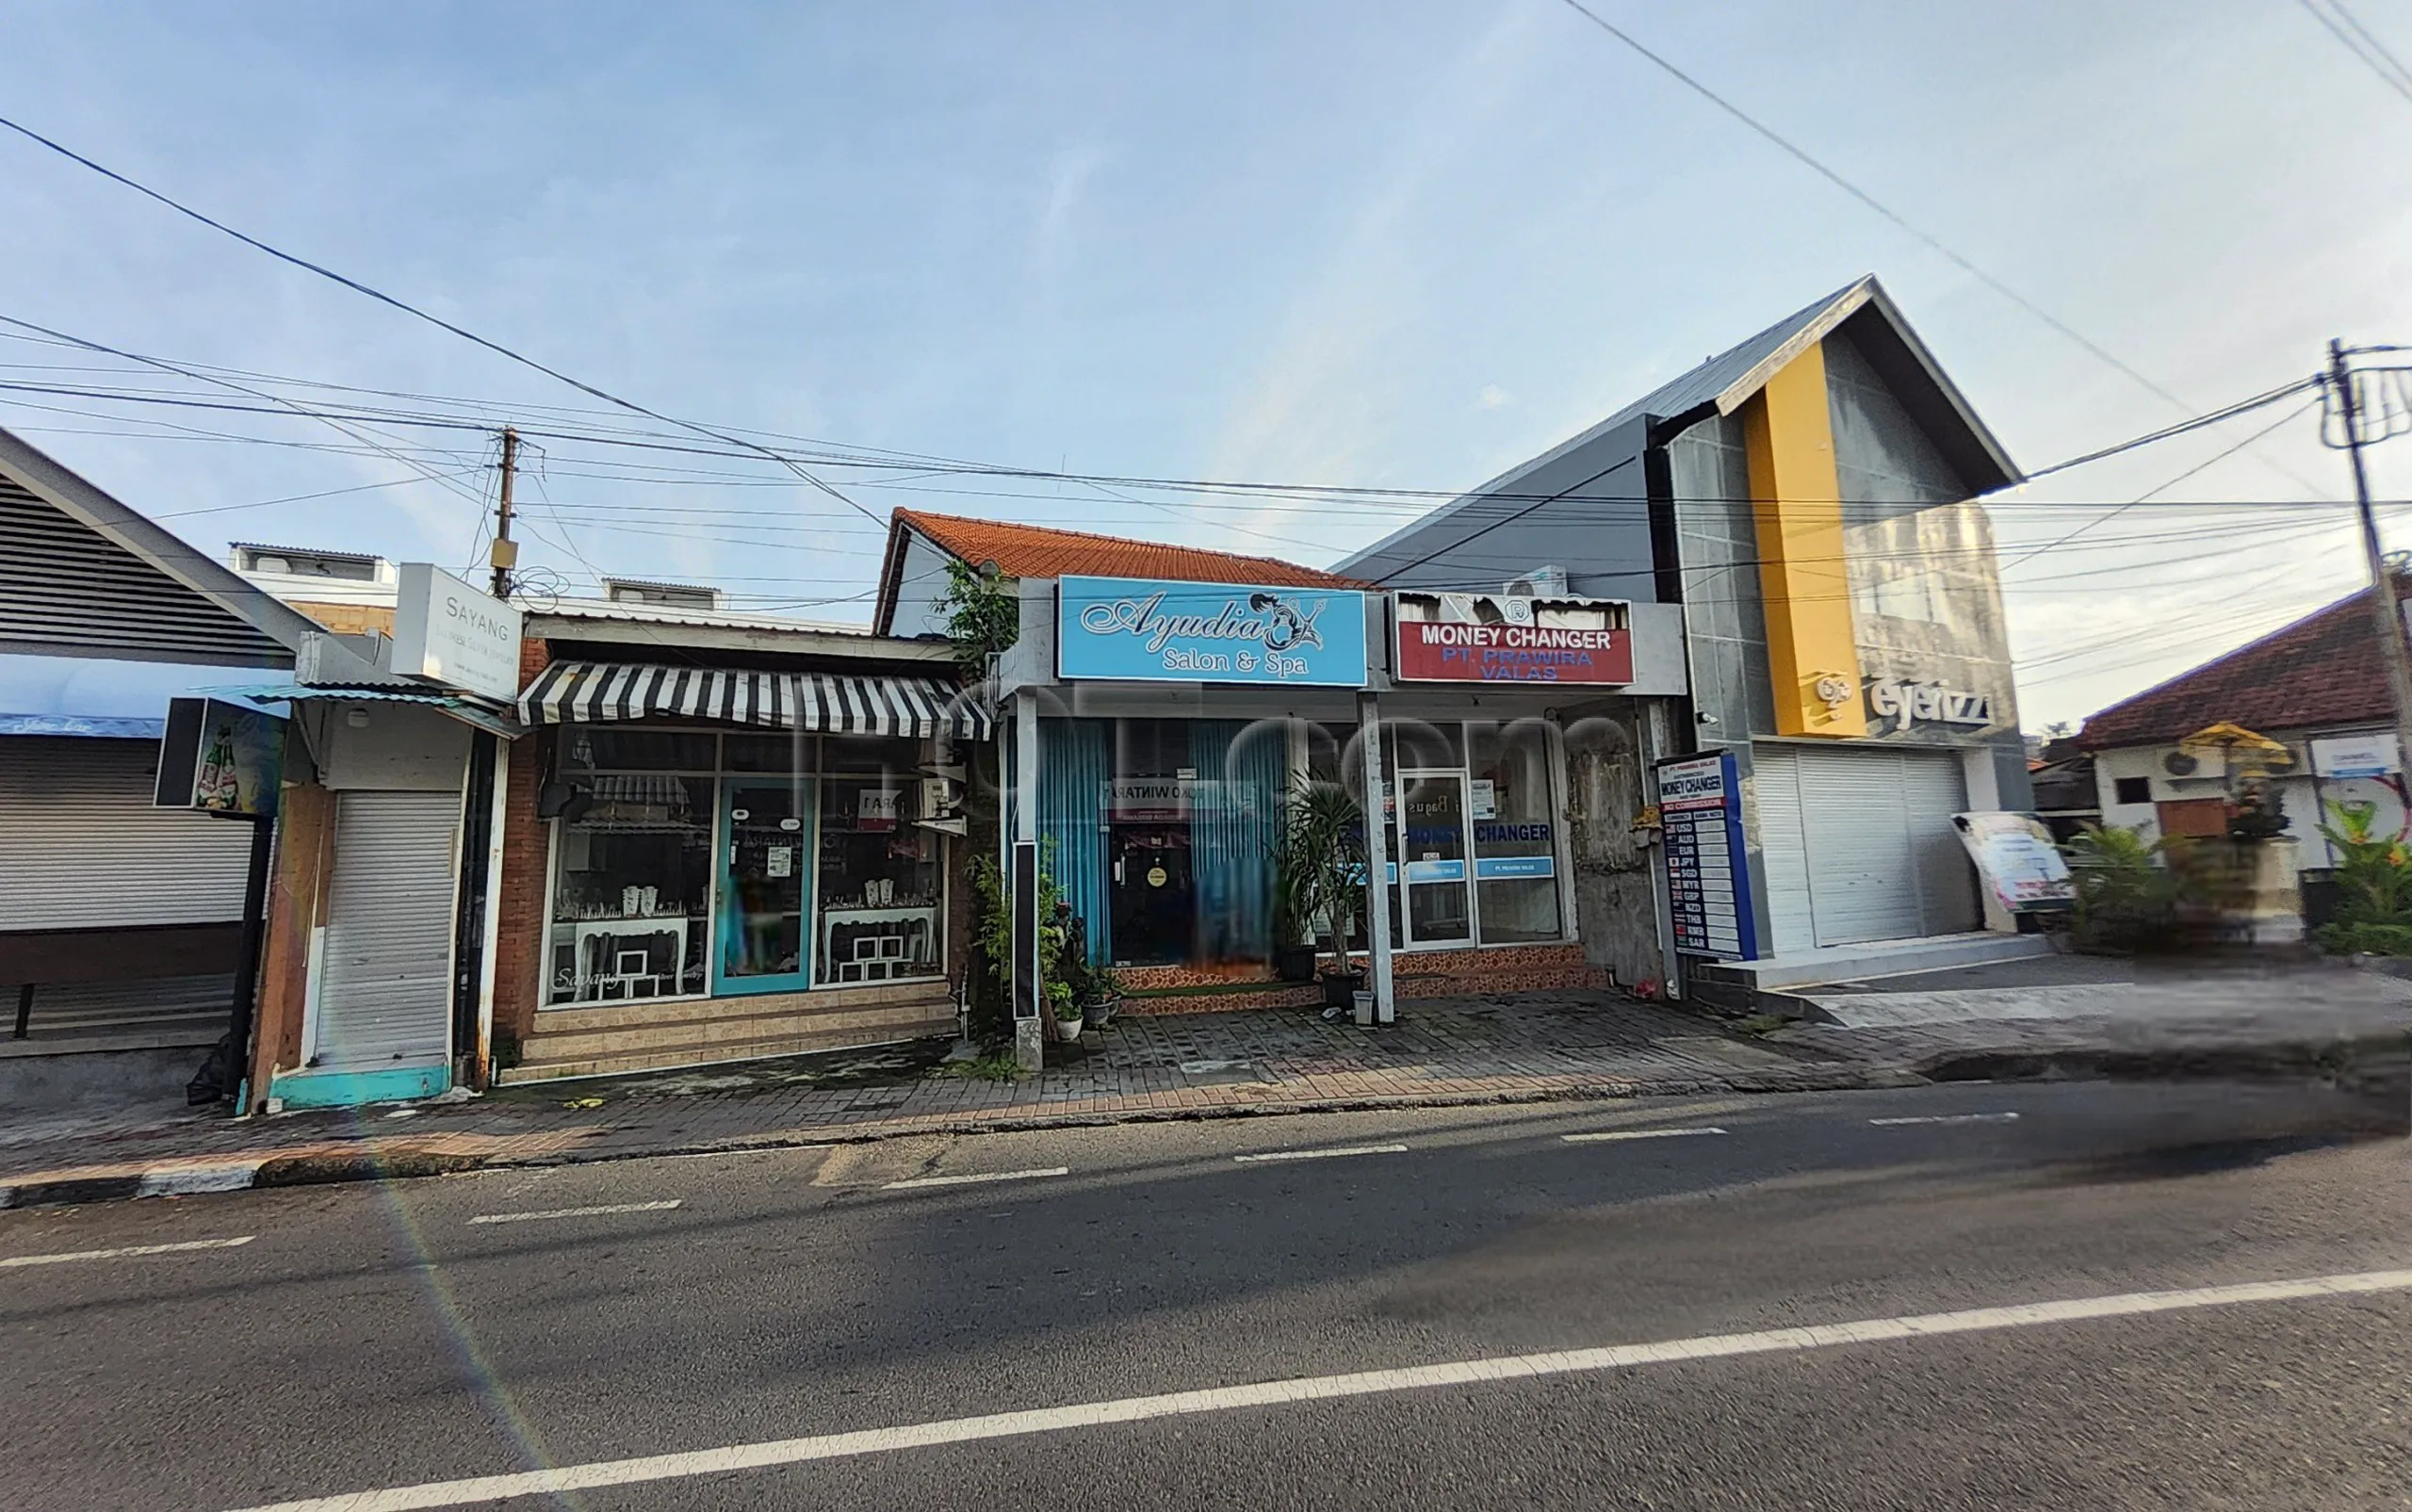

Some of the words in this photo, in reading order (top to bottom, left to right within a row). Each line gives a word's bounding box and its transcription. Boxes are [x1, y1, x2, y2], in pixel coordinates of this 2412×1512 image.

[446, 596, 508, 641] SAYANG
[1081, 591, 1265, 653] Ayudia
[1421, 625, 1501, 646] MONEY
[1506, 627, 1611, 649] CHANGER
[1162, 649, 1230, 672] Salon
[1237, 650, 1260, 672] &
[1264, 652, 1309, 677] Spa
[1484, 649, 1593, 665] PRAWIRA
[1480, 666, 1557, 680] VALAS
[1660, 780, 1685, 795] MONEY
[1685, 775, 1721, 793] CHANGER
[1475, 824, 1550, 842] CHANGER
[1677, 823, 1692, 833] USD
[1678, 835, 1694, 843] AUD
[1679, 846, 1694, 855] EUR
[1680, 857, 1694, 866] JPY
[1688, 937, 1704, 948] SAR
